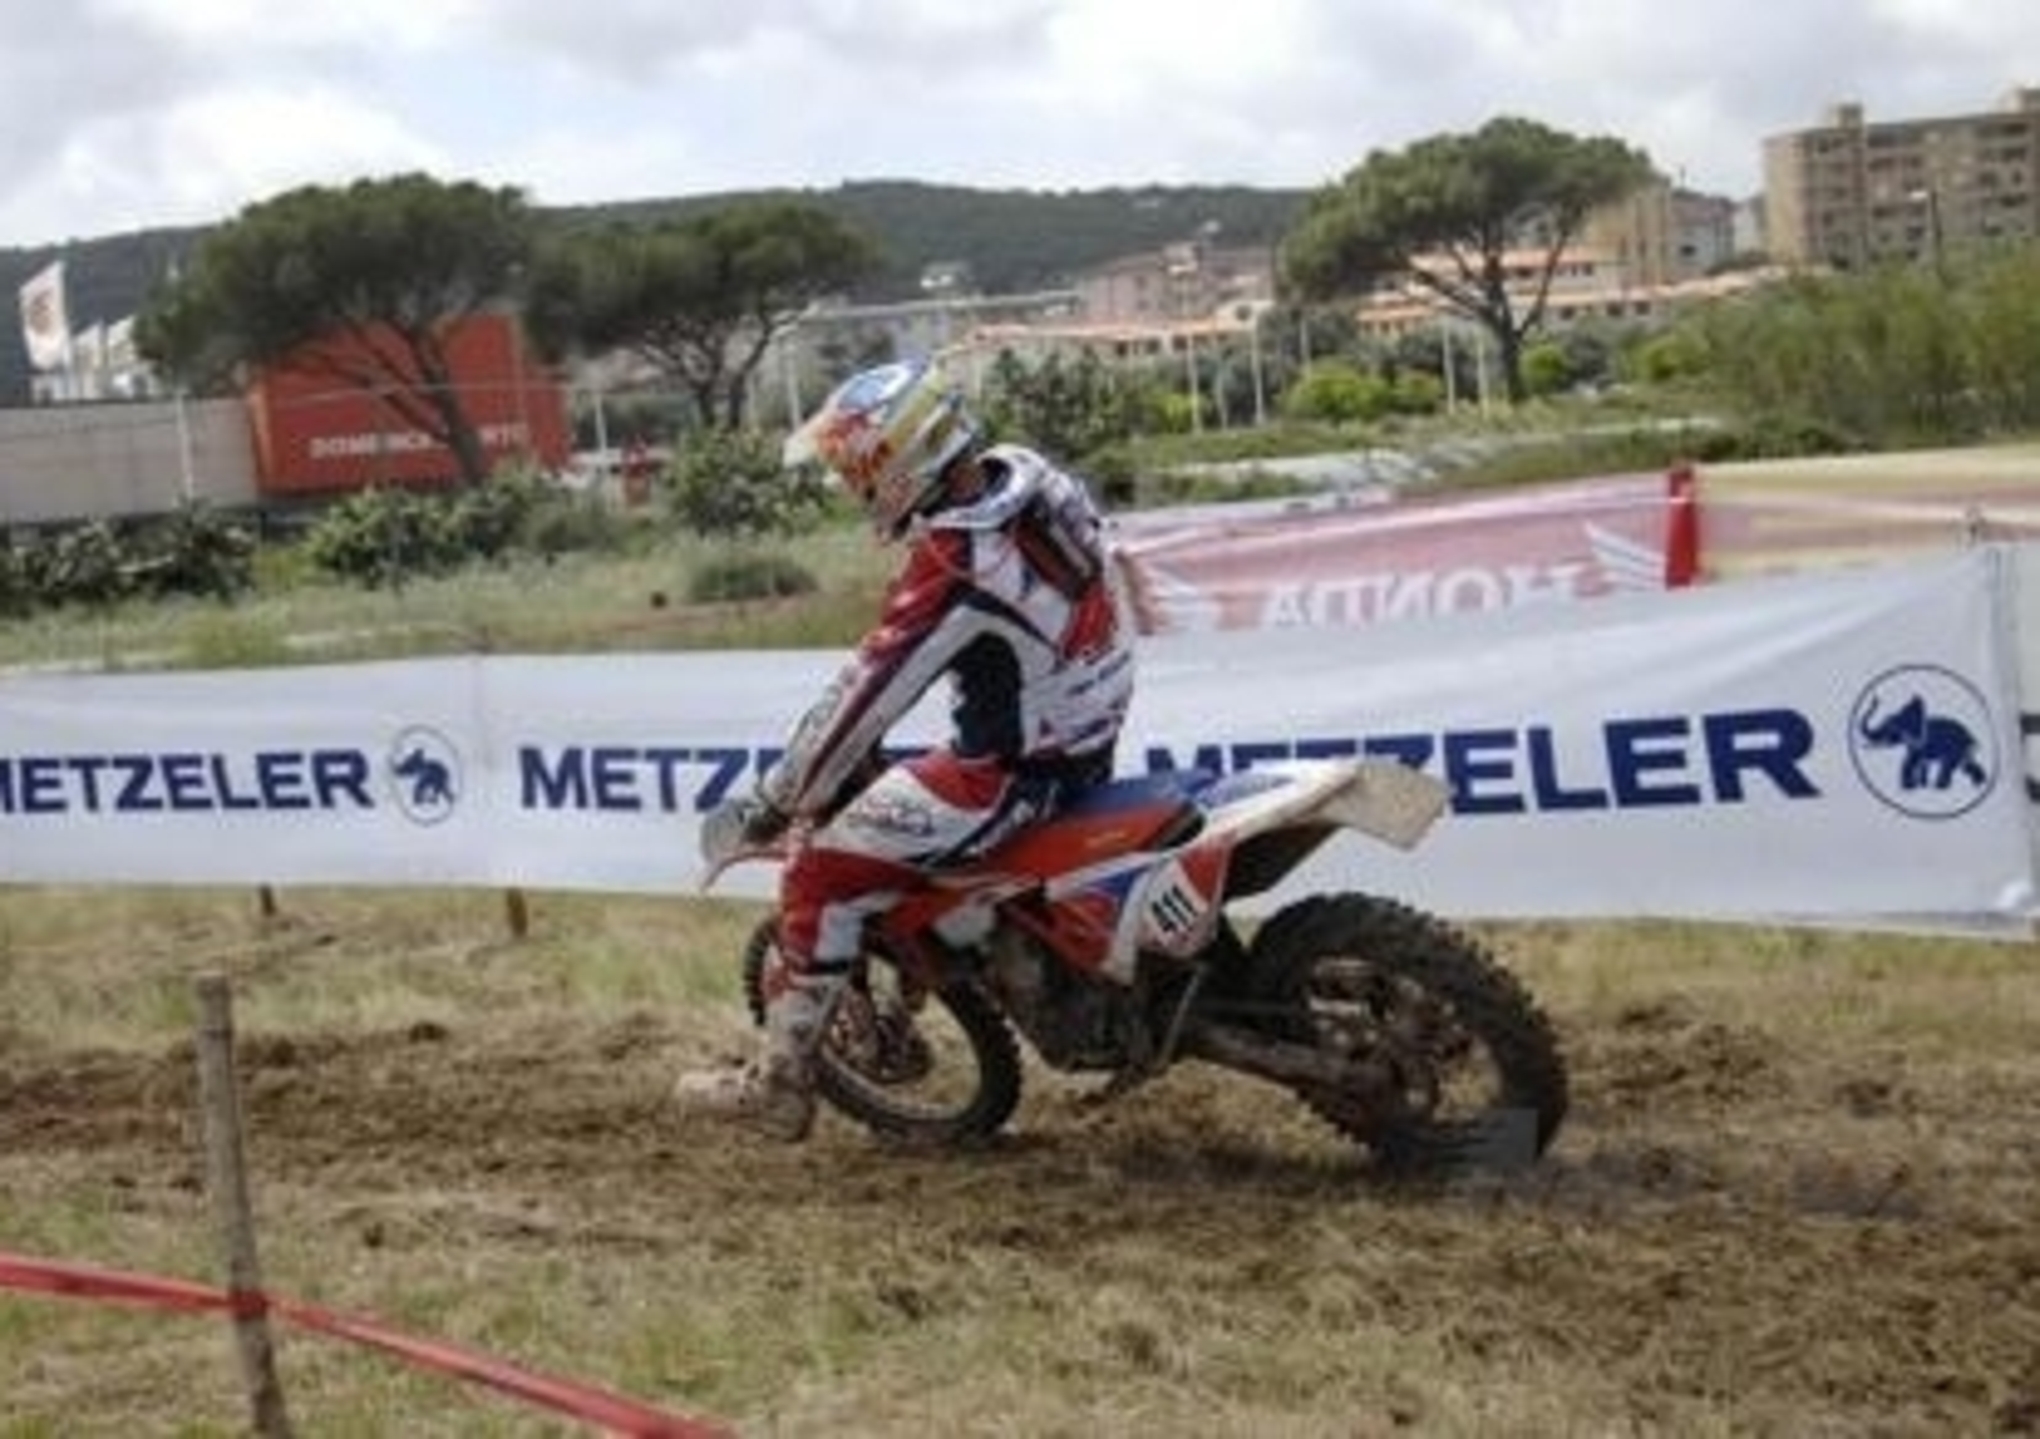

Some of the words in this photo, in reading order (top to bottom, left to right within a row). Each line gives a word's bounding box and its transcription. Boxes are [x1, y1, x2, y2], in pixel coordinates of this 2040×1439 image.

[0, 750, 375, 814] ETZELER
[519, 746, 786, 812] METZ
[1151, 883, 1199, 933] 411
